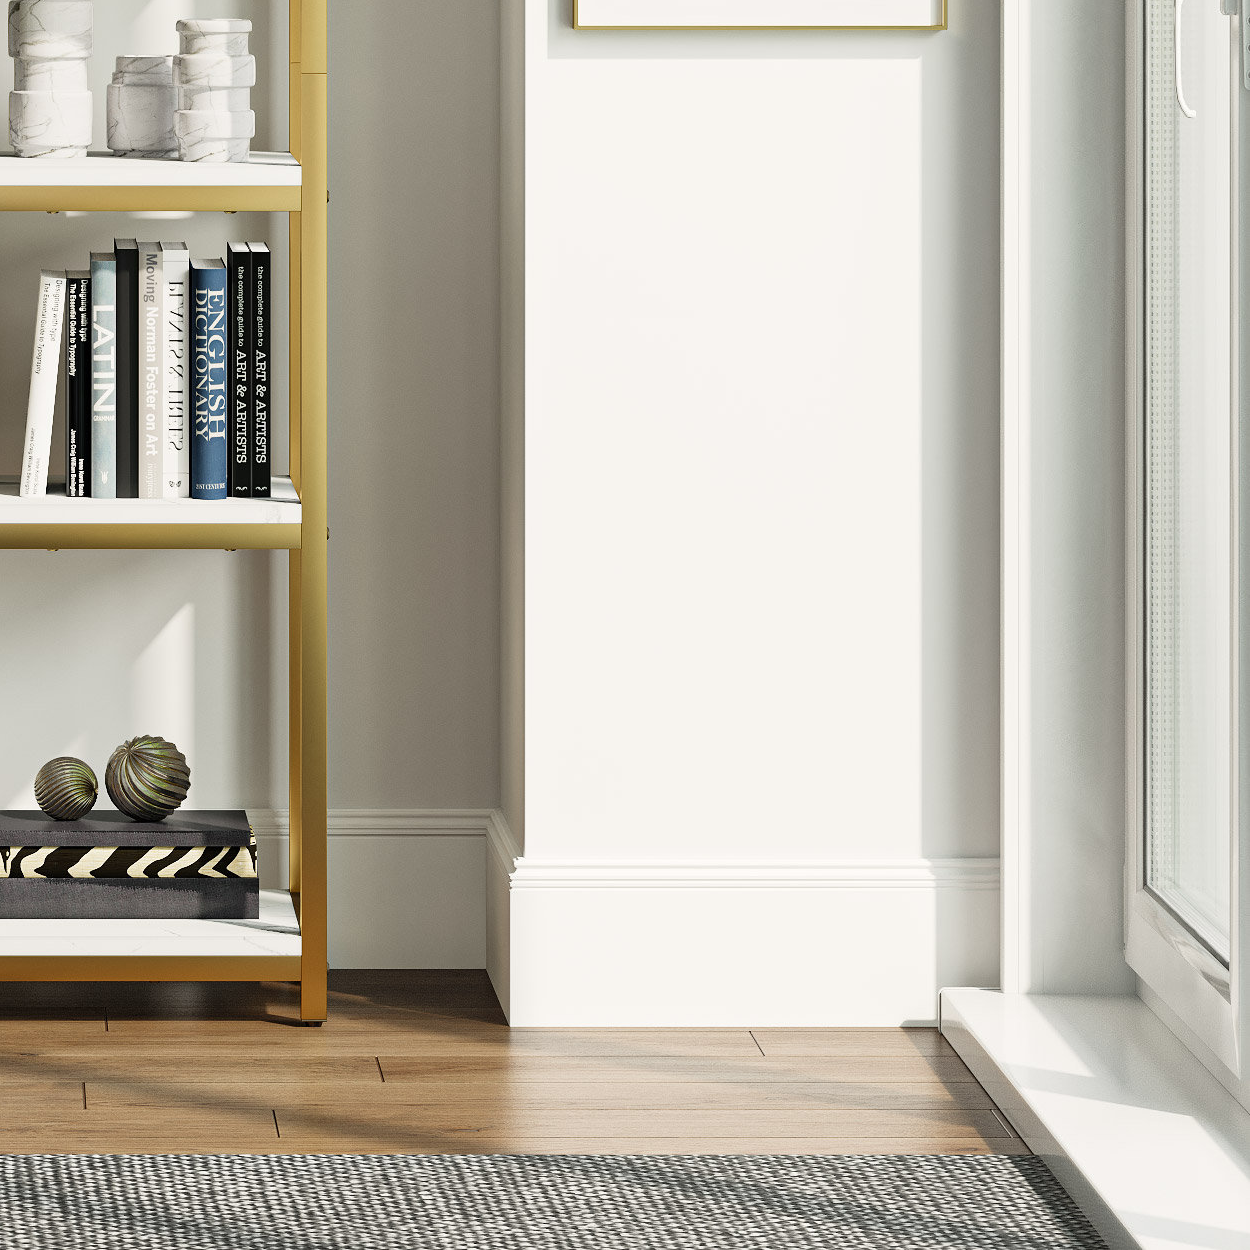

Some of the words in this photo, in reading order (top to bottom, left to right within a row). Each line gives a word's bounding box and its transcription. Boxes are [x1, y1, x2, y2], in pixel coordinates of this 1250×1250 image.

[144, 254, 158, 302] Moving
[79, 280, 88, 312] Designing
[237, 280, 245, 316] complete
[256, 280, 264, 316] complete
[79, 328, 88, 342] type
[80, 312, 88, 327] with
[146, 306, 158, 362] Norman
[237, 316, 245, 338] guide
[256, 316, 264, 338] guide
[93, 304, 114, 412] LATIN
[238, 338, 244, 346] to
[258, 338, 264, 346] to
[68, 344, 76, 376] Typography
[195, 288, 208, 442] DICTIONARY
[207, 287, 226, 442] ENGLISH
[236, 350, 247, 382] ART
[256, 350, 266, 382] ART
[146, 366, 158, 410] Foster
[236, 384, 247, 398] &
[256, 384, 266, 398] &
[146, 414, 156, 431] on
[236, 399, 247, 464] ARTISTS
[256, 399, 266, 464] ARTISTS
[146, 434, 158, 456] Art
